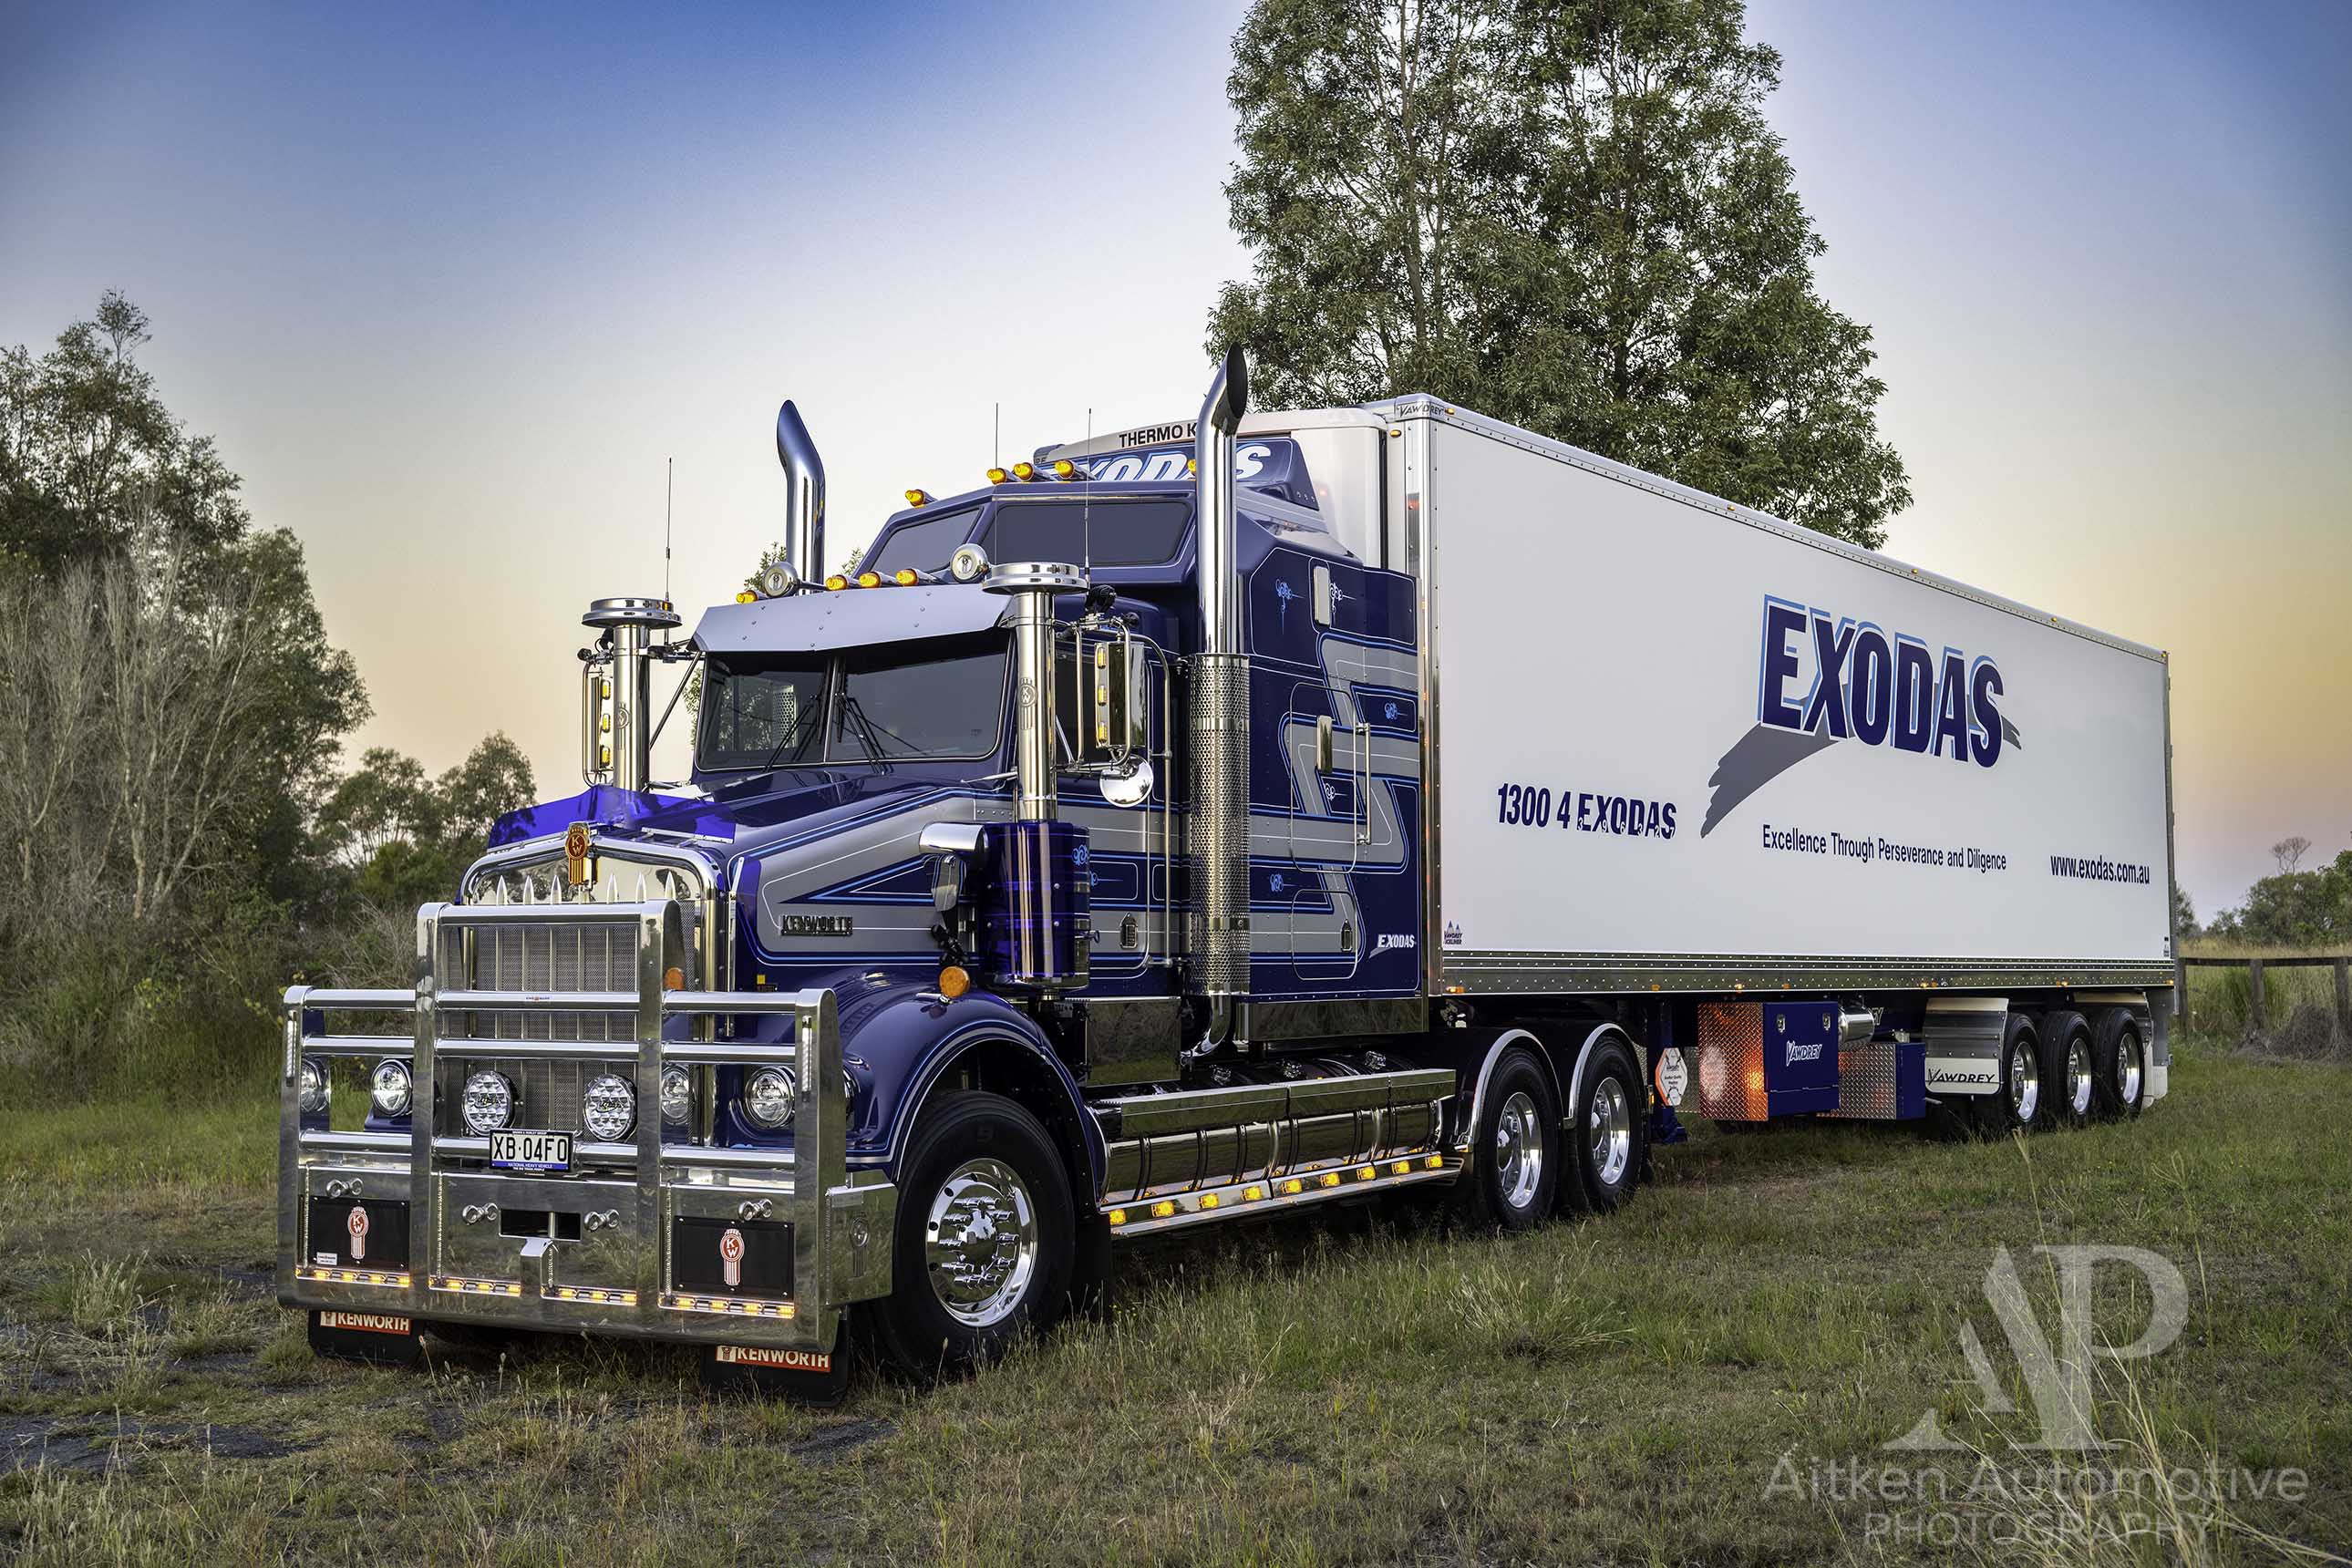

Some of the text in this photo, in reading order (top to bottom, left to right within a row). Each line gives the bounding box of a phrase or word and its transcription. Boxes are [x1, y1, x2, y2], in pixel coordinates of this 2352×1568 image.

[1119, 424, 1183, 448] THERMO
[1758, 593, 2005, 768] EXODAS
[1498, 783, 1677, 840] 1300 4 EXODAS
[1763, 824, 2006, 873] Excellence Through Perseverance and Diligence
[2050, 855, 2150, 884] www.exodas.com.au
[1377, 934, 1415, 948] EXODAS
[1786, 1040, 1822, 1067] VAWDREY
[1928, 1068, 1996, 1086] VAWDREY
[337, 1313, 409, 1331] KENWORTH
[738, 1348, 829, 1367] KENWORTH
